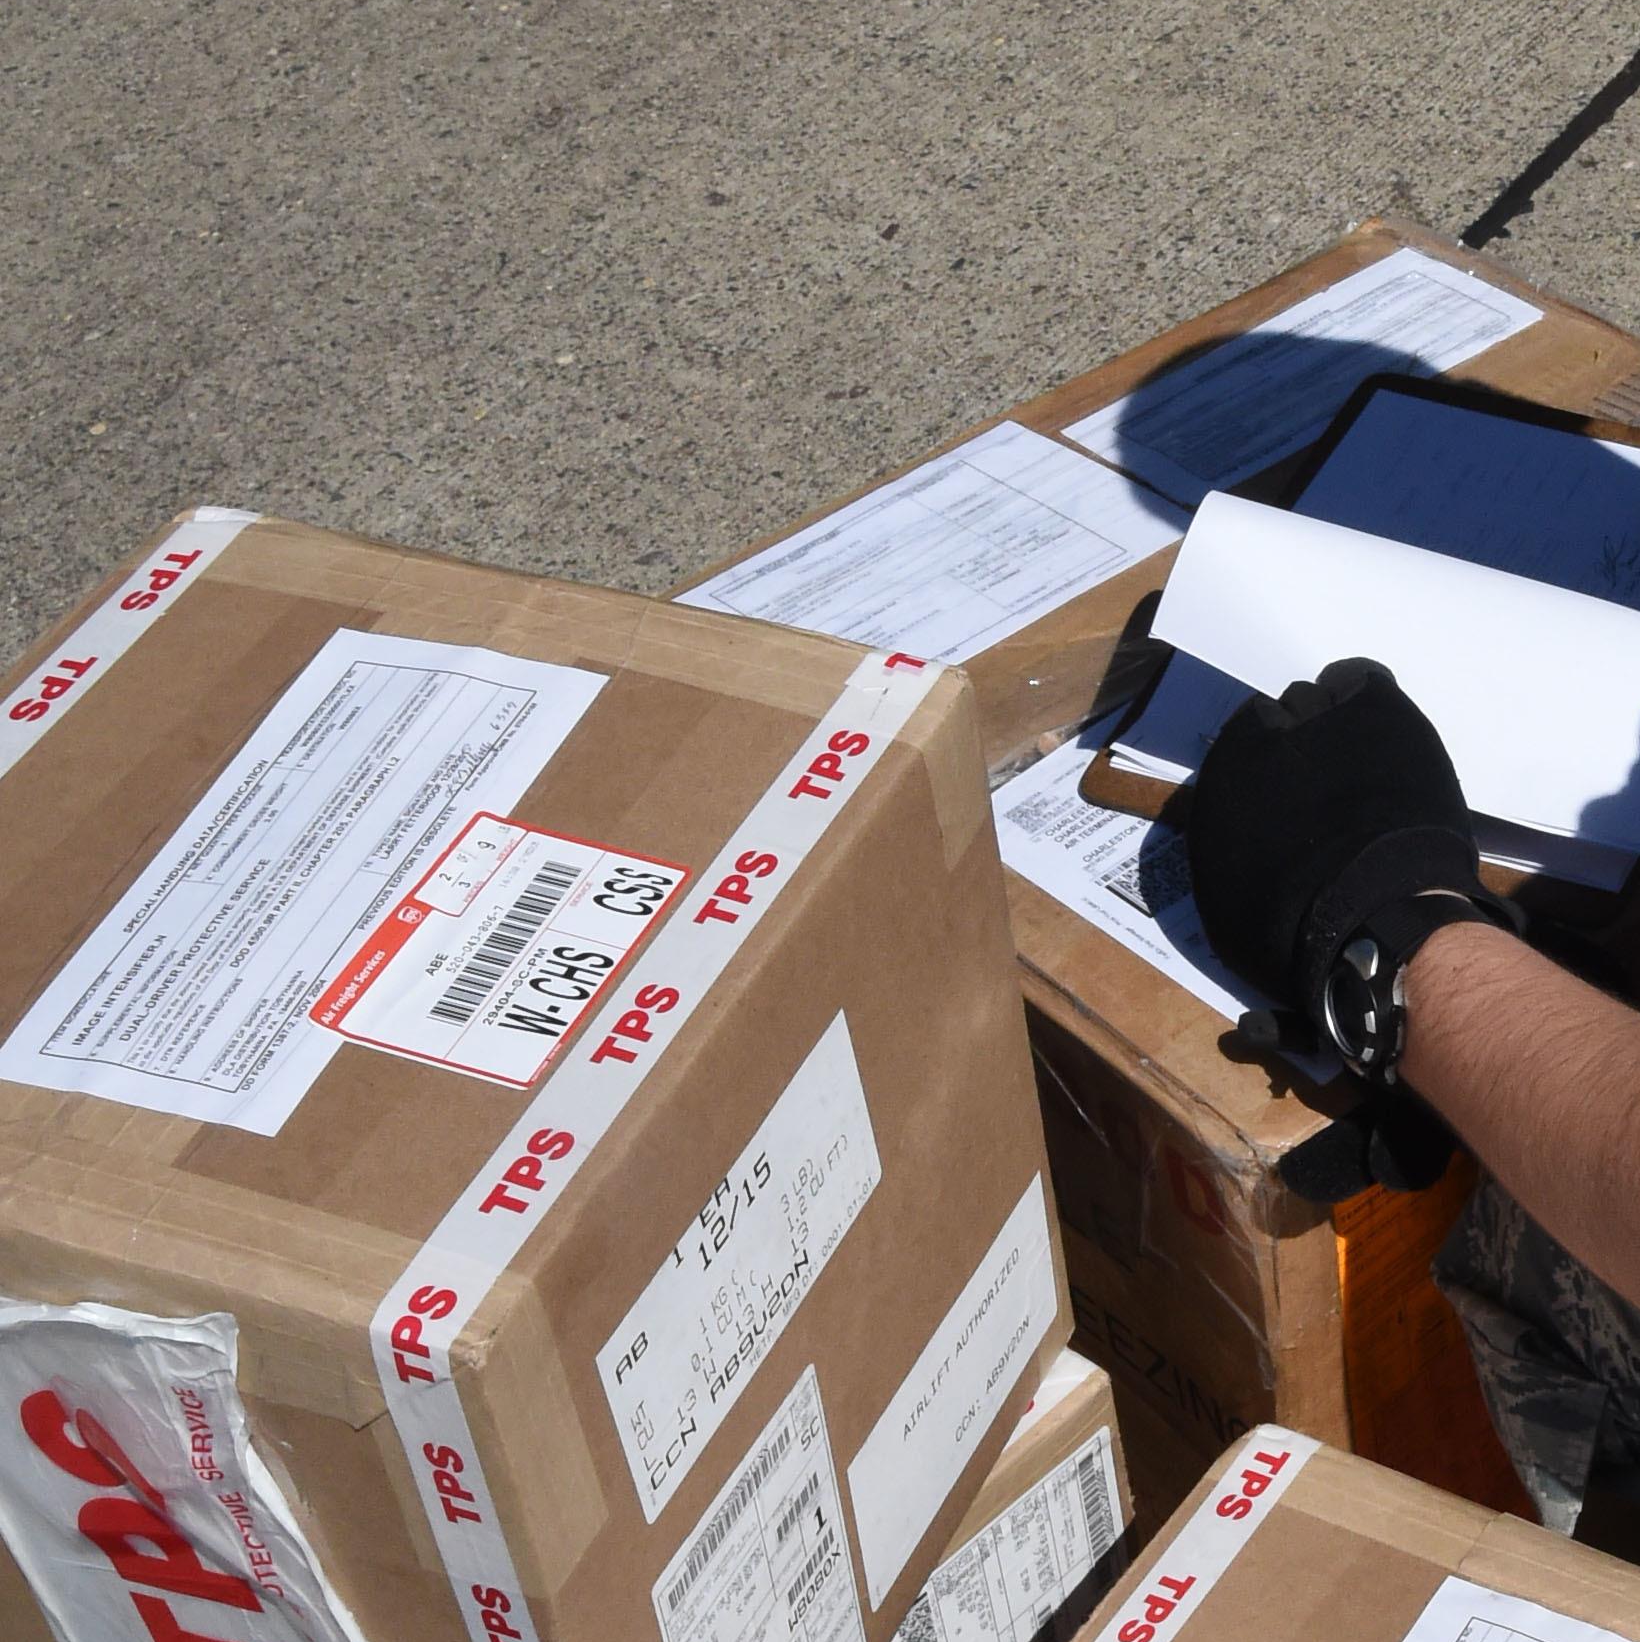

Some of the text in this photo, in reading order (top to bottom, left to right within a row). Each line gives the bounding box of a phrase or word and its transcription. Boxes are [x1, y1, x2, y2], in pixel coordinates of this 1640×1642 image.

[121, 548, 203, 613] TPS
[10, 656, 97, 723] TPS
[790, 730, 871, 801] TPS
[122, 759, 270, 933] SPECIAL HANDLING DATA/CERTIFICATION
[379, 834, 405, 859] LARRY
[474, 840, 497, 851] 9
[1054, 806, 1106, 843] CHARLESTO
[228, 947, 252, 967] DOD
[245, 912, 279, 946] 4500.9R
[272, 887, 299, 911] PART
[298, 837, 338, 877] CHAPTER
[345, 766, 393, 818] PARAGRAPH
[356, 805, 457, 930] PREVIOUS EDITION IS OBSOLETE
[436, 872, 453, 881] 2
[456, 879, 472, 889] 3
[588, 864, 676, 920] CSS
[695, 850, 779, 925] TPS
[117, 968, 184, 1041] DUAL-DRIVER
[176, 903, 235, 967] PROTECTIVE
[228, 858, 271, 901] SERVICE
[422, 952, 450, 976] ABE
[444, 905, 505, 973] 520-043-806-7
[232, 1012, 273, 1059] DISTRIBUTION
[268, 969, 305, 1011] TOBYHANNA
[317, 949, 388, 1024] Air Freight Services
[480, 946, 548, 1025] 29404-SC-PM
[71, 1010, 107, 1046] IMAGE
[231, 1034, 269, 1077] TOBYHANNA
[240, 1076, 256, 1090] DD
[250, 1049, 277, 1076] FORM
[293, 998, 314, 1017] NOV
[308, 979, 329, 997] 2004
[590, 984, 680, 1064] TPS
[480, 1127, 576, 1215] TPS
[696, 1148, 772, 1273] 12/15
[630, 1399, 648, 1434] WT
[709, 1282, 728, 1316] KG
[779, 1189, 790, 1213] 3
[791, 1153, 814, 1196] LB)
[636, 1130, 850, 1454] CU 0.1 CU M 1.2 CU FT)
[391, 1284, 459, 1384] TPS
[614, 1327, 649, 1387] AB
[643, 1217, 810, 1473] L 13 W 13 H 13
[649, 1246, 810, 1493] CCN AB9V2DN
[902, 1244, 1019, 1442] AIRLIFT AUTHORIZED
[171, 1385, 225, 1483] SERVICE
[800, 1413, 820, 1454] SC
[954, 1393, 980, 1446] CCN:
[423, 1442, 481, 1524] TPS
[812, 1499, 827, 1536] 1
[1216, 1451, 1294, 1522] TPS
[787, 1540, 841, 1634] W8080X
